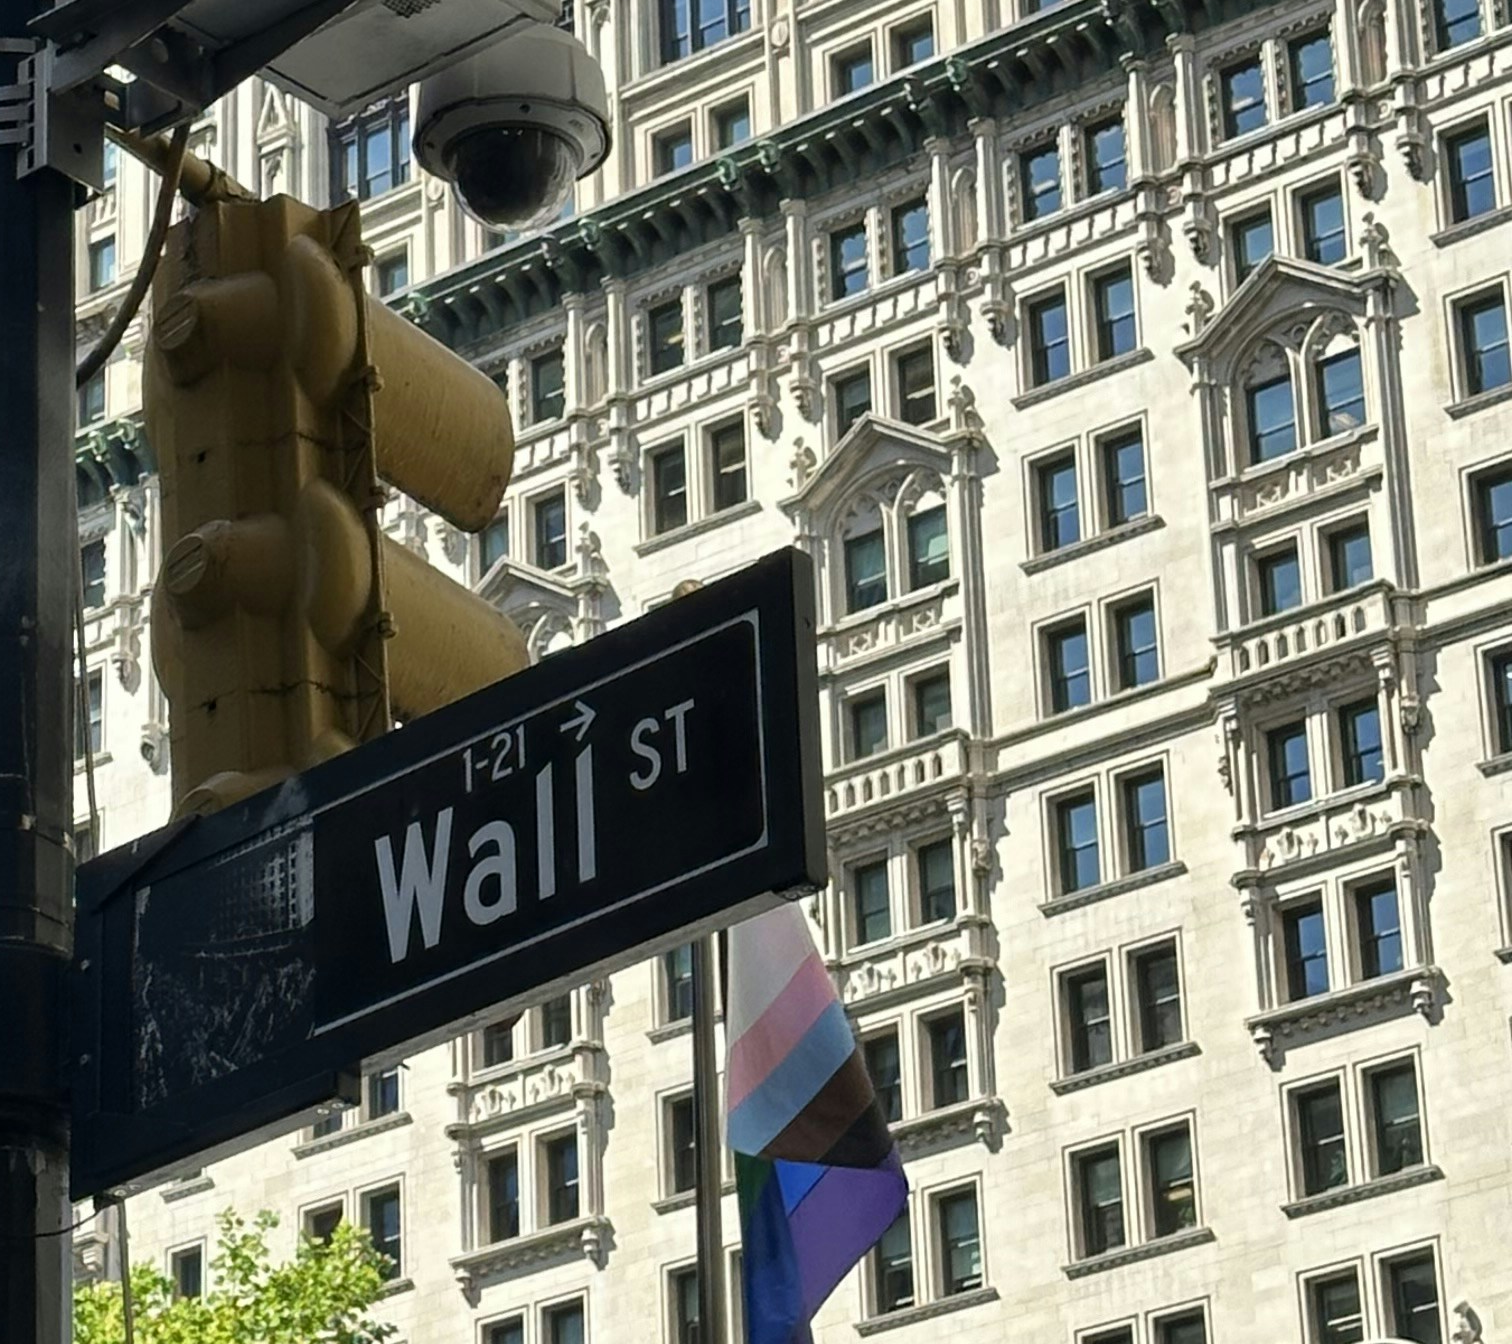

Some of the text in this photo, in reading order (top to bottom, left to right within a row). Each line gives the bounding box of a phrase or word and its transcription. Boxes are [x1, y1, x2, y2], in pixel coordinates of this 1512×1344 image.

[374, 698, 695, 964] Wall ST
[463, 723, 527, 793] 1-21
